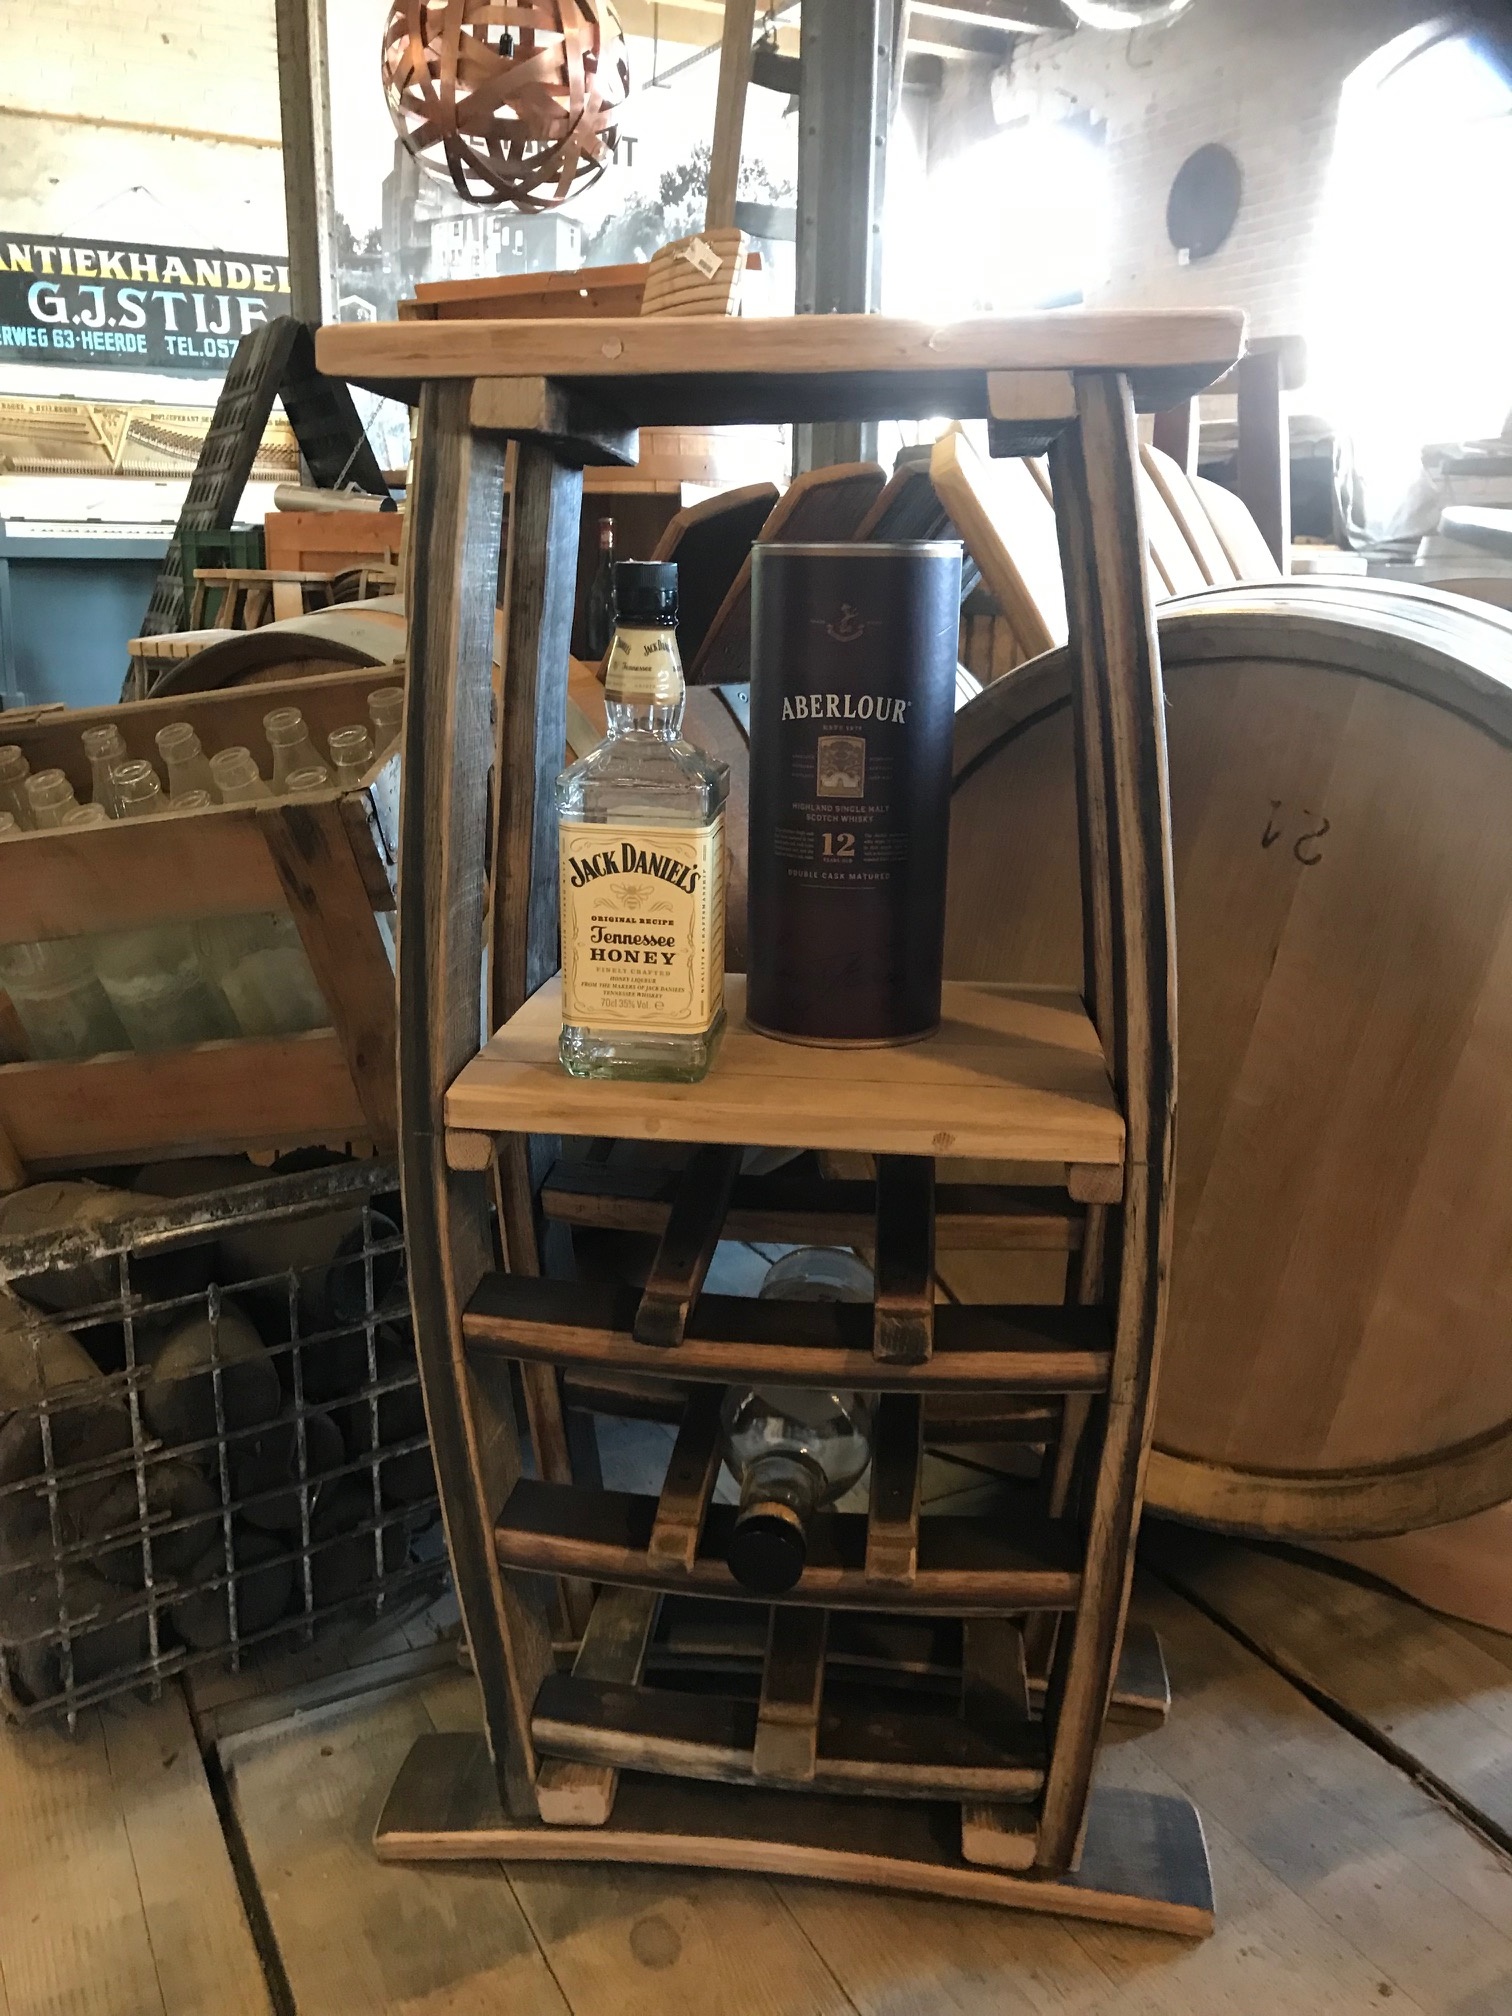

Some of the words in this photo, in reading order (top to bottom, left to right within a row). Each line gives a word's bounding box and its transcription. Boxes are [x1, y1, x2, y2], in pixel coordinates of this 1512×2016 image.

[0, 325, 49, 348] RWEG
[781, 693, 907, 724] ABERLOUR
[792, 802, 833, 812] HIGHLAND
[834, 804, 866, 813] SINGLE
[868, 805, 890, 813] MALT
[806, 813, 839, 822] SCOTCH
[840, 815, 875, 823] WHISKY
[821, 832, 856, 857] 12
[568, 850, 621, 888] JACK
[621, 842, 702, 894] DANIEL'S
[787, 868, 819, 879] DOUBLE
[821, 872, 845, 880] CASK
[848, 872, 891, 880] MATURED
[591, 915, 637, 924] ORIGINAL
[639, 917, 675, 926] RECIPE
[590, 925, 676, 948] Tennessee
[589, 947, 676, 966] HONEY
[596, 966, 628, 974] FINELY
[630, 968, 671, 976] CRAFTED
[600, 997, 617, 1008] 70cl
[618, 998, 635, 1009] 35%
